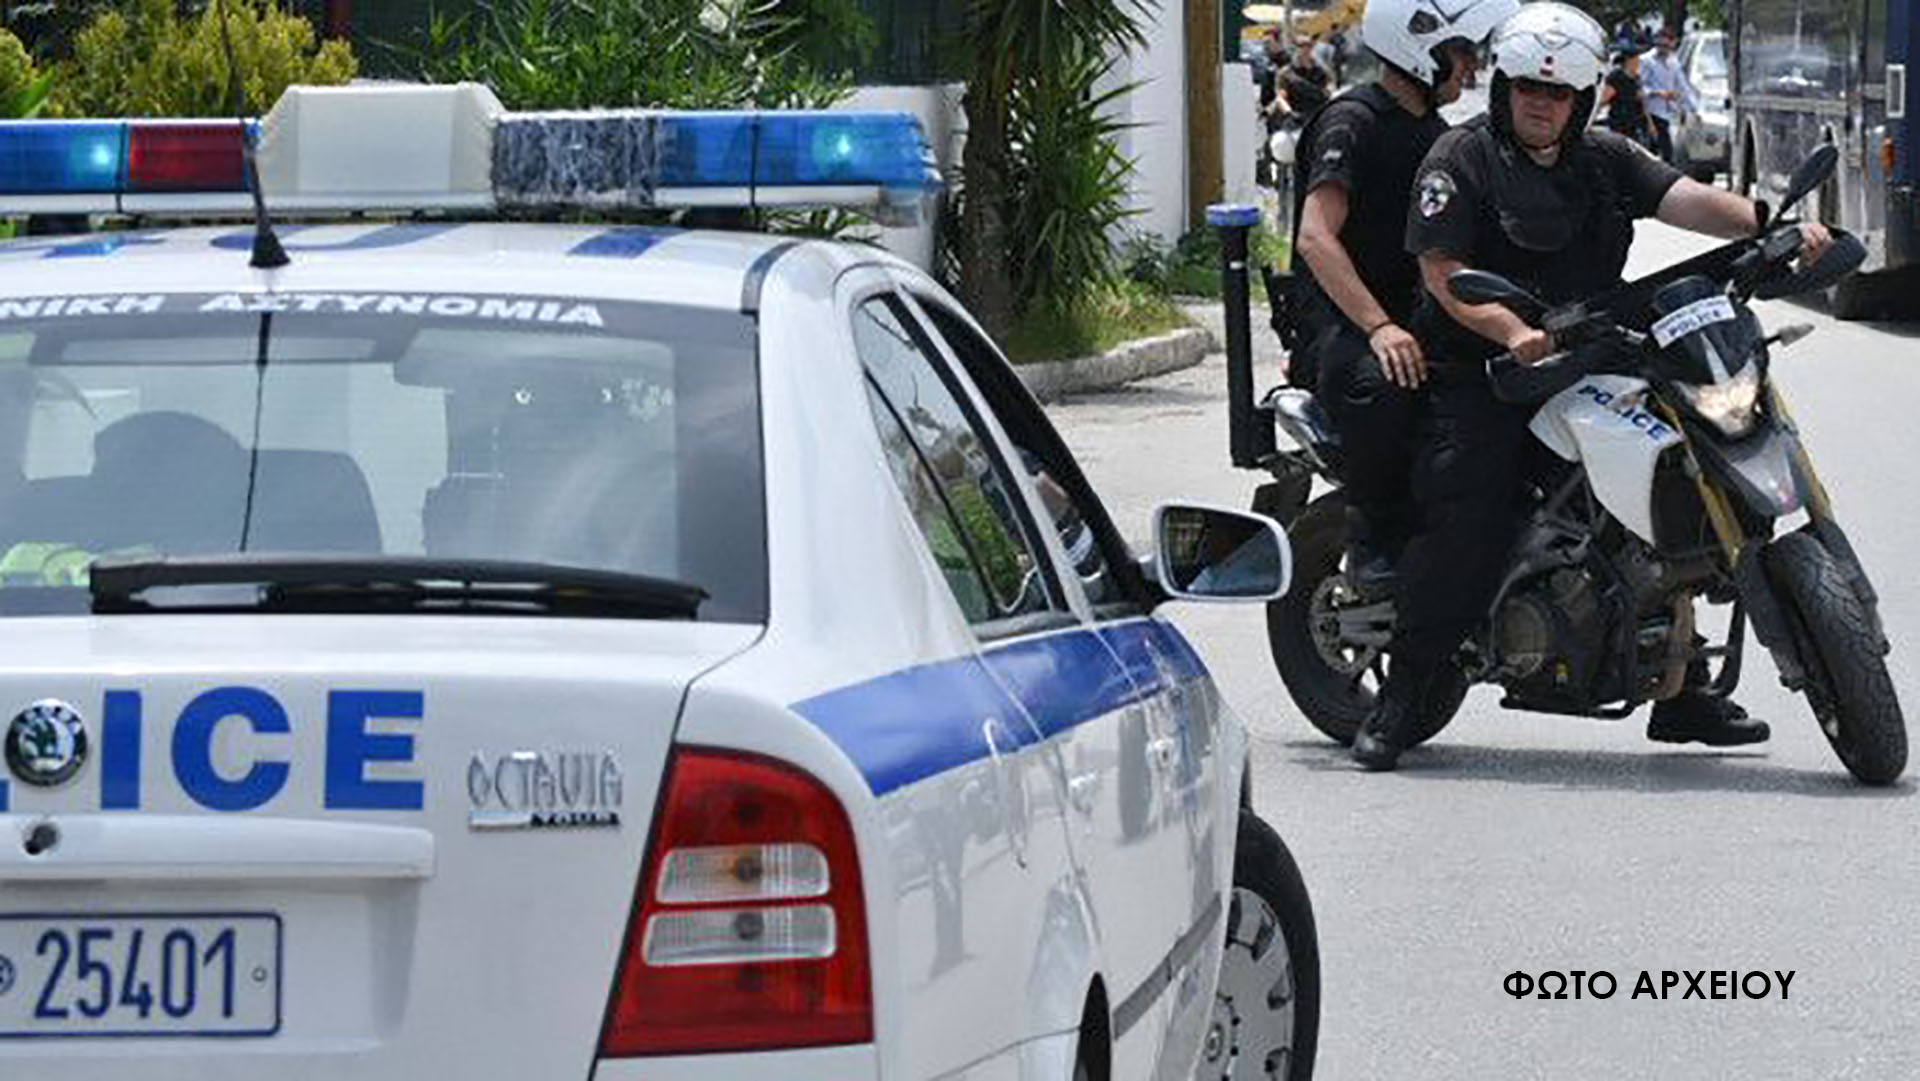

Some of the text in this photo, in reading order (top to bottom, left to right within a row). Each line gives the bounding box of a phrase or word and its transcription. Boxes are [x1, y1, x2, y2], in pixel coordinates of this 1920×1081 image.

[199, 293, 604, 327] ΑΣΤΥΝΟΜΙΑ
[467, 753, 622, 808] OCTAVIA
[33, 928, 237, 1019] 25401
